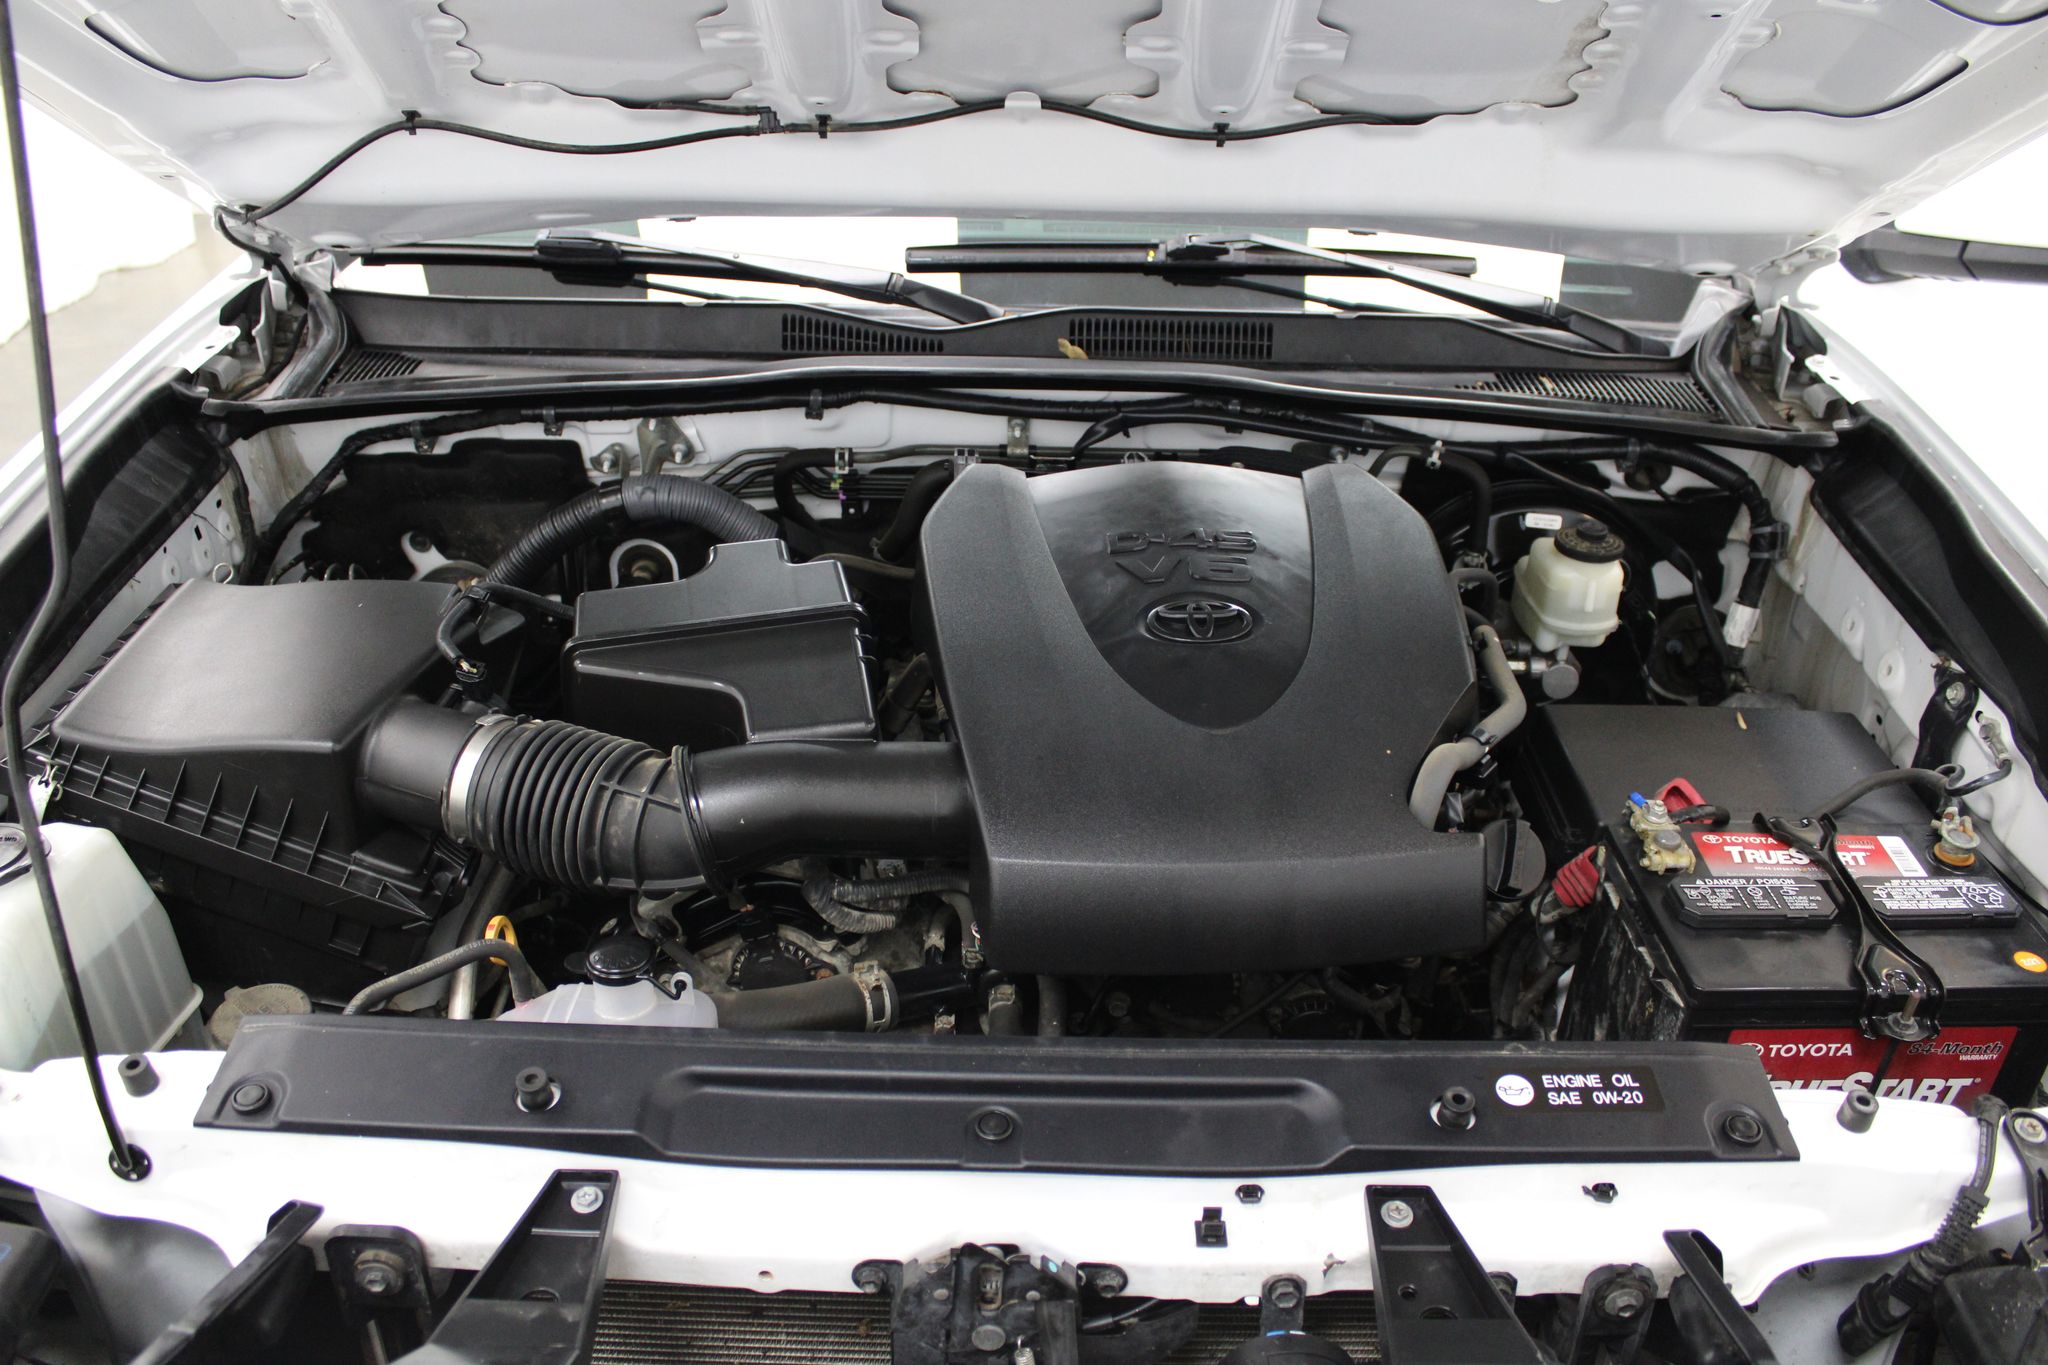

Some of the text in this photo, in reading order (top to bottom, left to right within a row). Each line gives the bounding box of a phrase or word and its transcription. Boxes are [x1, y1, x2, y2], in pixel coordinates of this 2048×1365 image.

[1115, 555, 1253, 584] V6
[1723, 835, 1778, 844] TOYOTA
[1769, 1043, 1853, 1057] TOYOTA
[1541, 1073, 1640, 1088] ENGINE OIL
[1547, 1091, 1644, 1105] SAE 0W-20
